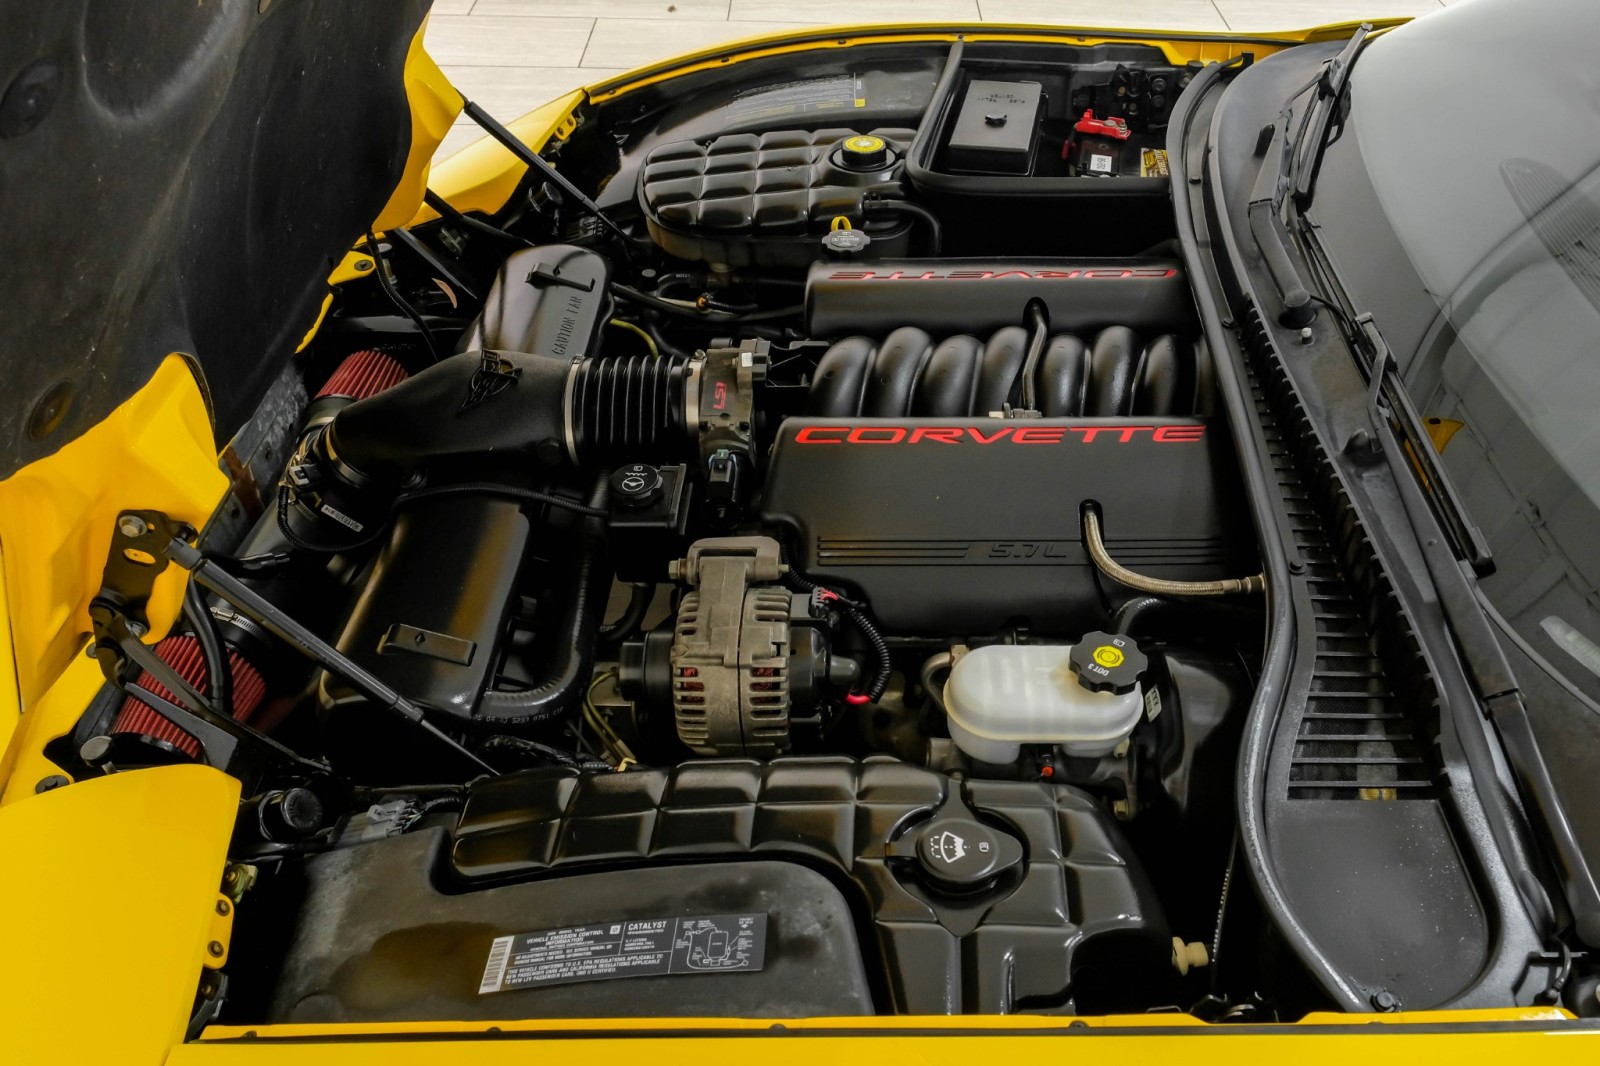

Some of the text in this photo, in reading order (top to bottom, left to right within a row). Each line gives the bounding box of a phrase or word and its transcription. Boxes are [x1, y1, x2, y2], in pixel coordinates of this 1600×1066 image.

[828, 268, 1178, 280] CORVETTE
[552, 316, 576, 355] CAUTION
[795, 424, 1207, 445] CORVETTE
[988, 543, 1067, 558] 5.7L
[1093, 666, 1110, 677] DOT
[628, 920, 668, 930] CATALYST
[527, 936, 548, 944] VEHICLE
[550, 934, 578, 942] EMISSION
[546, 937, 584, 946] INFORMATION
[594, 956, 626, 964] REGULATIONS
[598, 961, 630, 969] REGULATIONS
